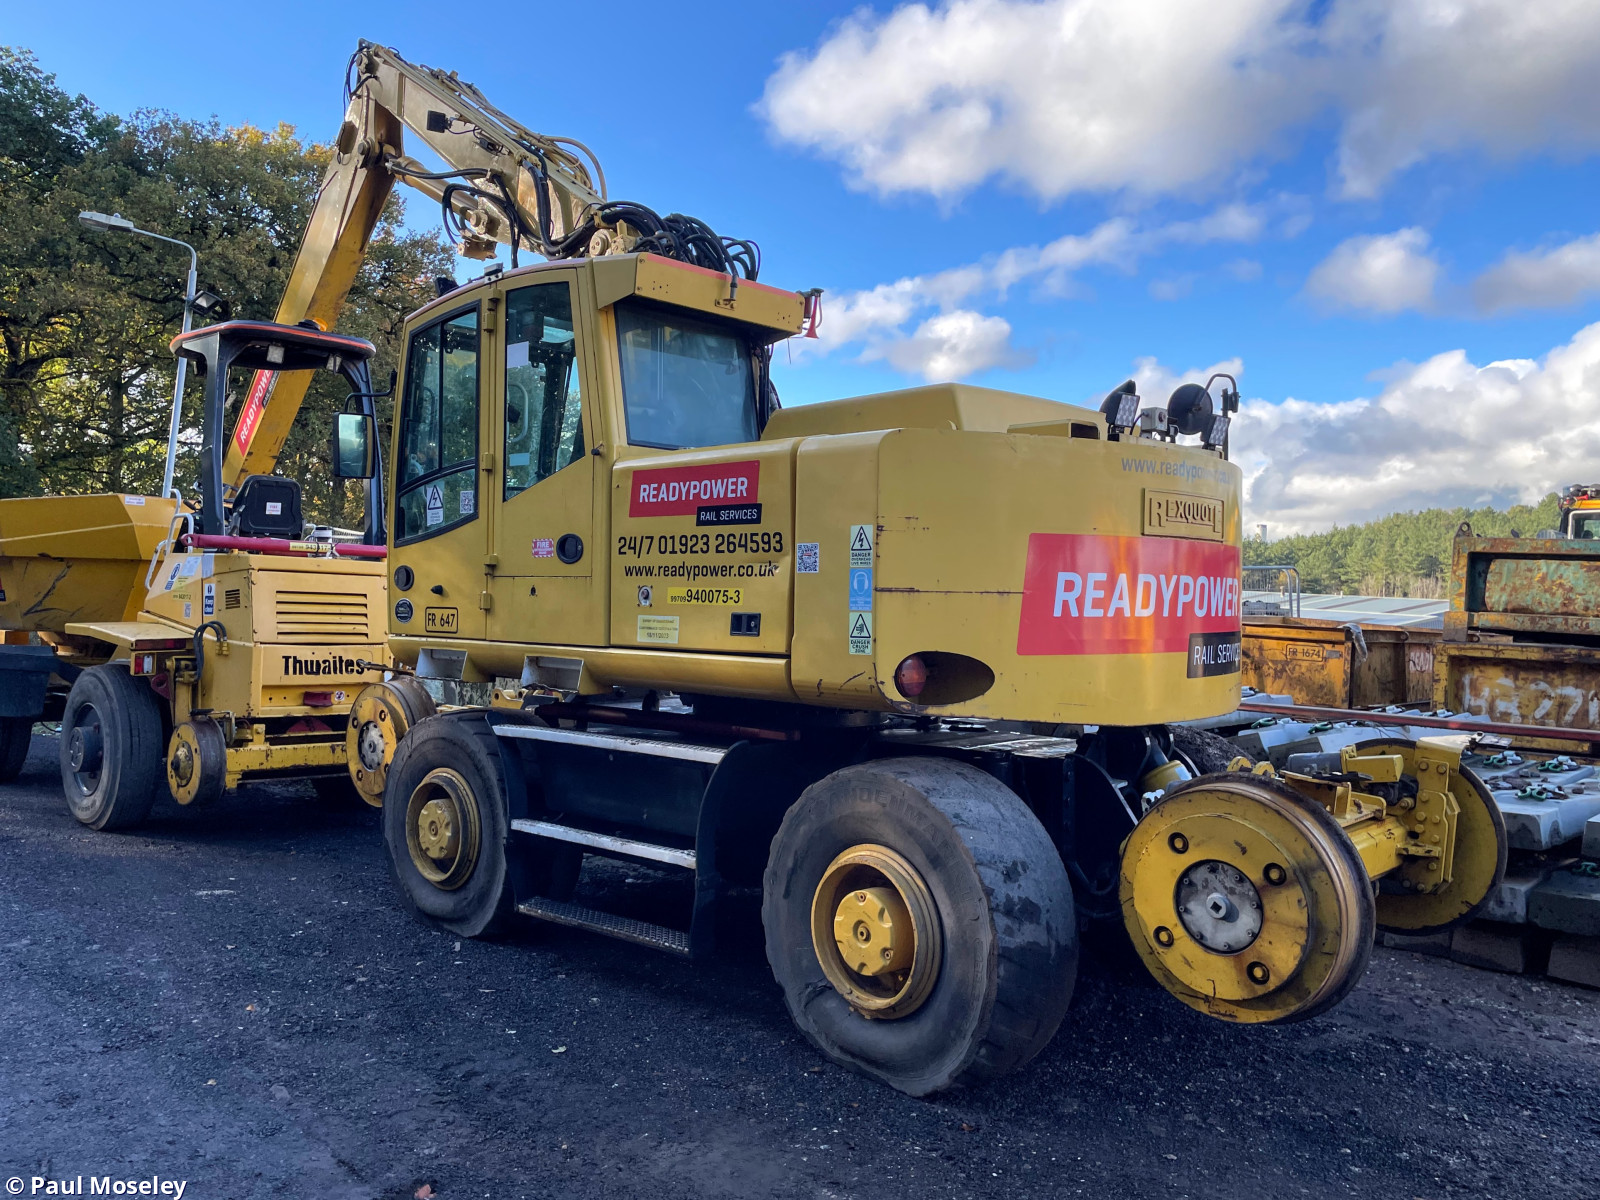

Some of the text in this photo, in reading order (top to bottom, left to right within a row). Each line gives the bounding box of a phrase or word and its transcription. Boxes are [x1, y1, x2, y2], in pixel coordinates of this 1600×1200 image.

[240, 370, 271, 443] READYPOWE
[639, 476, 748, 503] READYPOWER
[700, 508, 758, 521] RAIL SERVICES
[617, 531, 783, 559] 24/7 01923 264593
[624, 561, 776, 581] www.readypower.co.uk
[686, 588, 740, 604] 940075-3
[1053, 571, 1239, 618] READYPOWER
[427, 613, 456, 627] FR 647
[1193, 645, 1215, 665] RAIL
[1302, 648, 1321, 658] 1674
[282, 655, 364, 676] Thwaites
